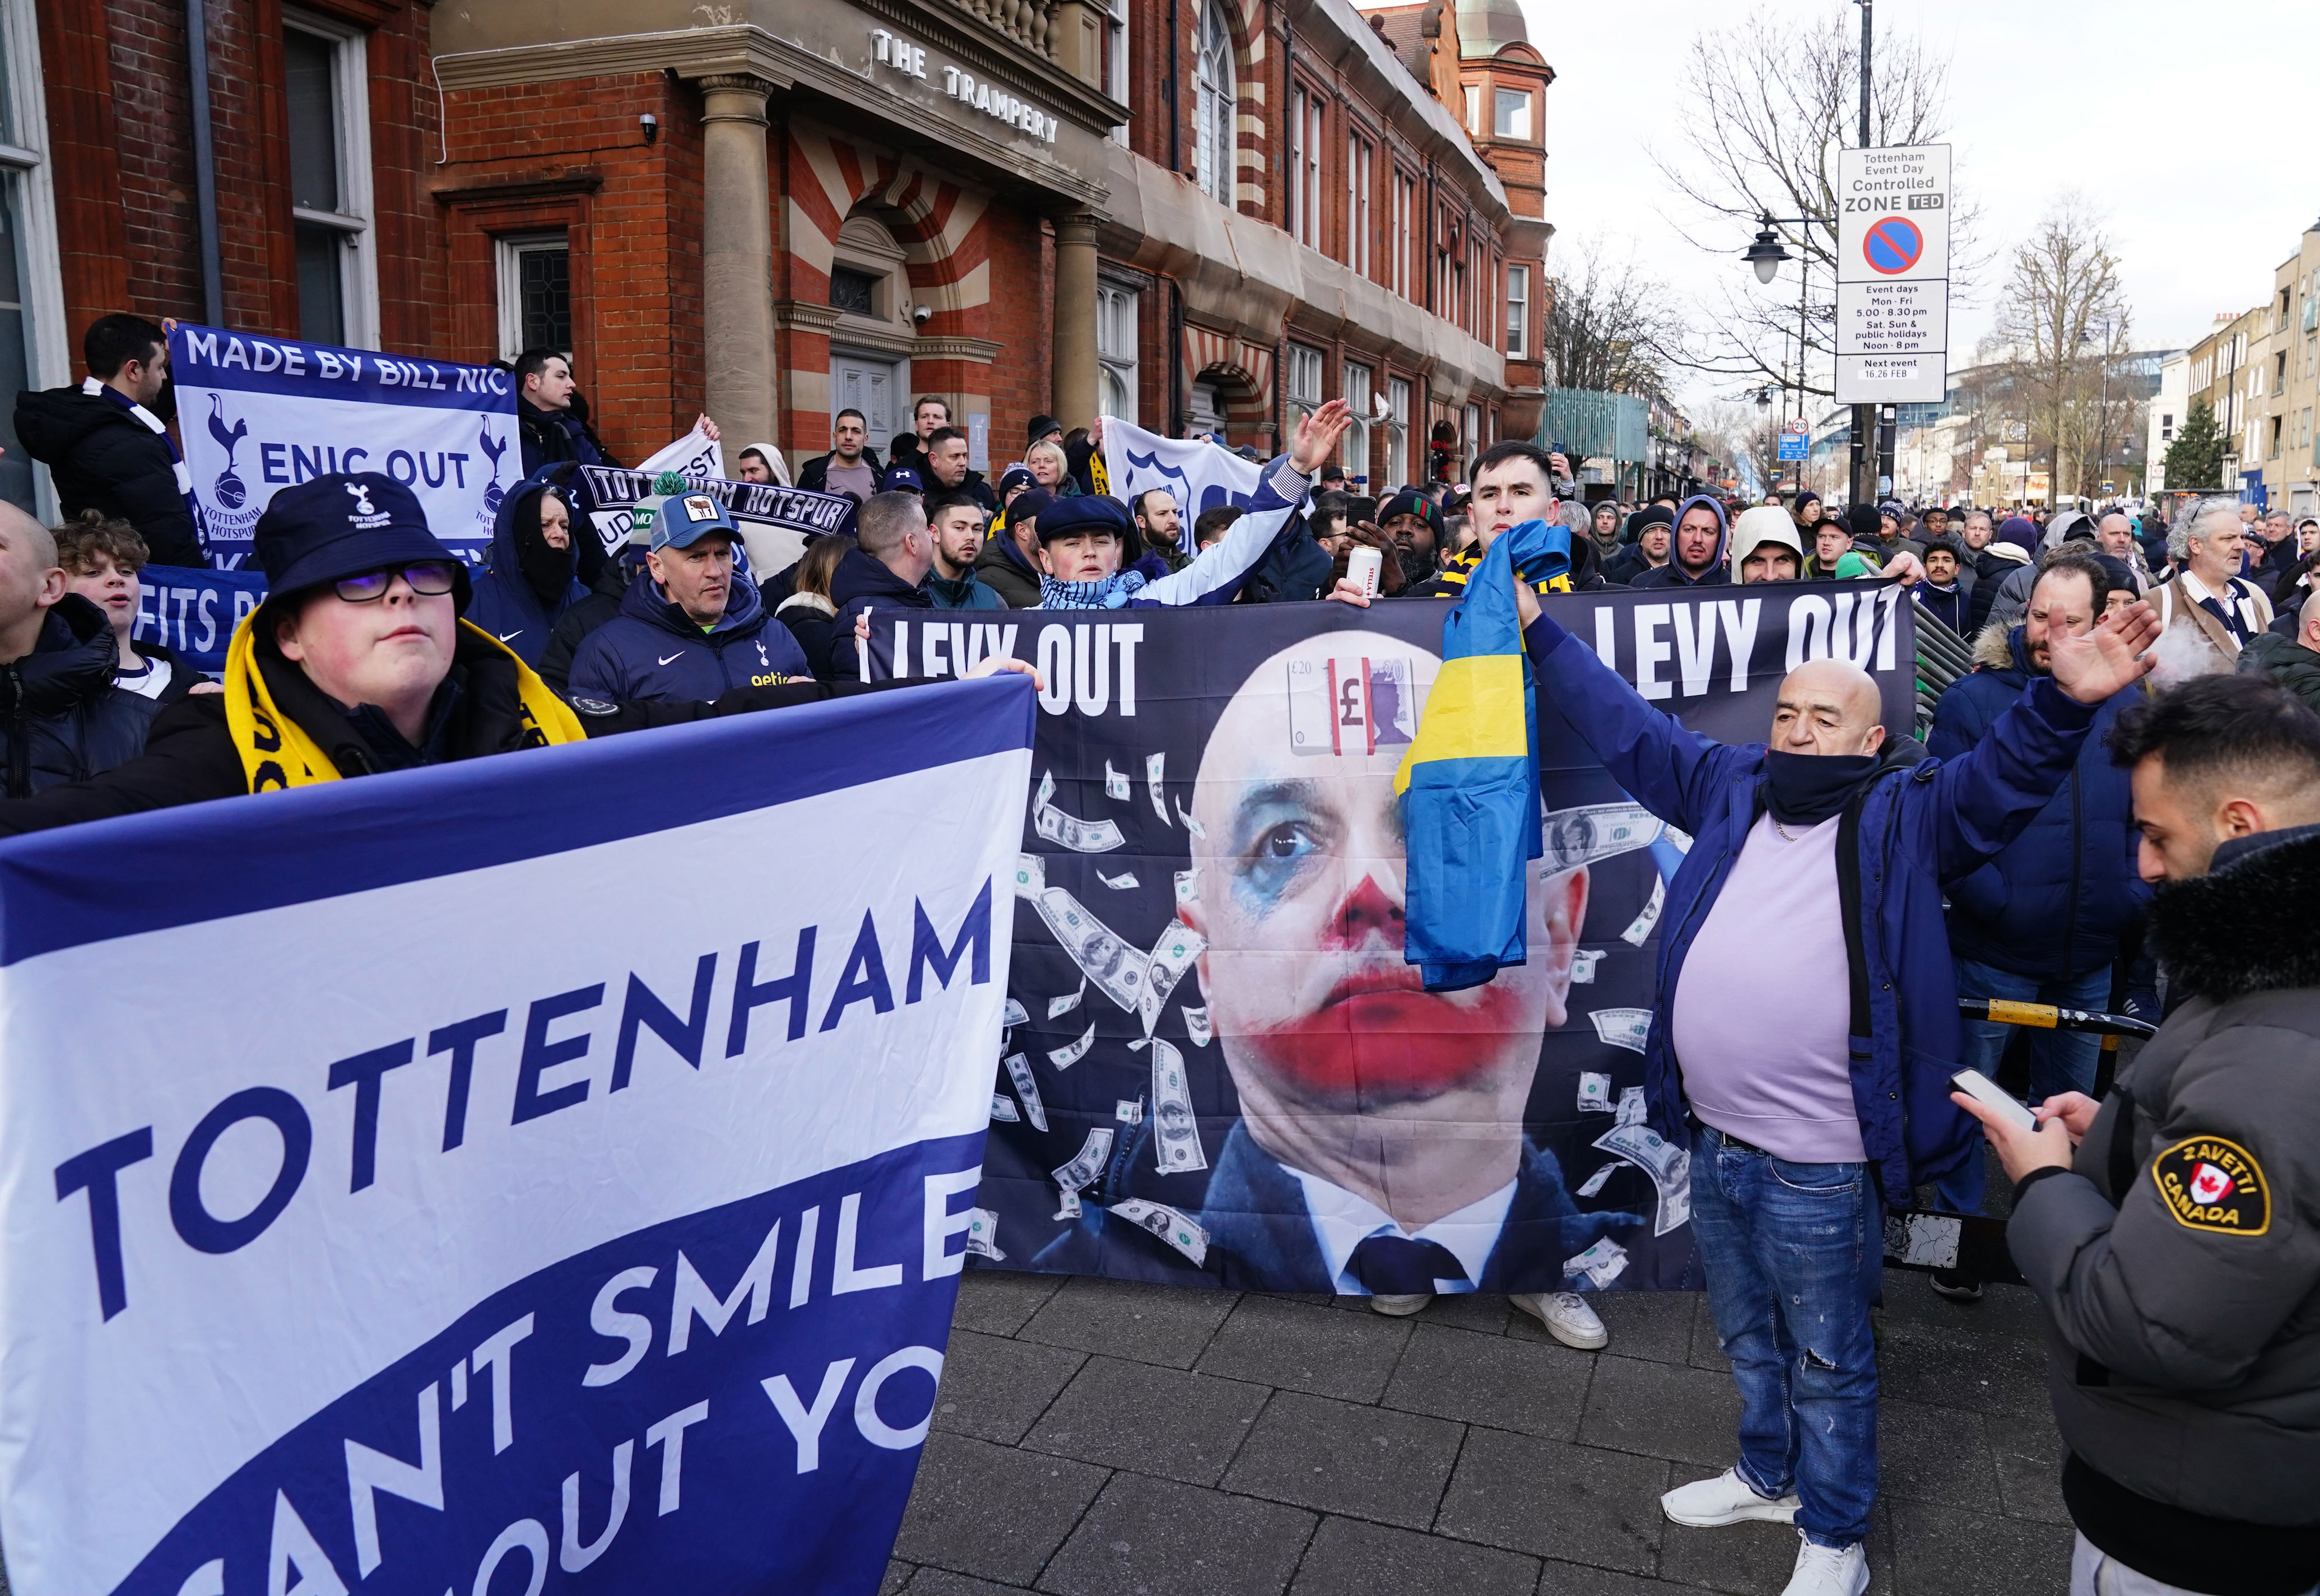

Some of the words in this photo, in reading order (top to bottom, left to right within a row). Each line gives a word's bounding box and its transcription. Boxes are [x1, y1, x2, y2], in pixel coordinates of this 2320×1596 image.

[872, 29, 927, 80] THE
[943, 65, 1058, 143] TRAMPERY
[1863, 152, 1925, 164] Tottenham
[1866, 165, 1898, 175] Event
[1903, 164, 1924, 174] Day
[1845, 196, 1901, 212] ZONE
[1911, 196, 1941, 209] TED
[1852, 176, 1934, 192] Controlled
[1896, 285, 1918, 294] days
[1856, 331, 1884, 339] public
[1888, 330, 1927, 339] holidays
[185, 329, 305, 376] MADE
[320, 351, 362, 381] BY
[373, 359, 447, 390] BILL
[456, 367, 508, 395] NIC
[261, 443, 369, 483] ENIC
[386, 450, 469, 489] OUT
[204, 505, 263, 525] TOTTENHAM
[745, 487, 842, 530] HOTSPUR
[1037, 623, 1144, 716] OUT
[1291, 661, 1312, 674] £20
[1384, 659, 1403, 681] 20
[1594, 598, 1761, 700] LEVY
[54, 873, 992, 1323] TOTTENHAM
[2183, 1143, 2257, 1194] ZAVETTI
[2164, 1172, 2239, 1226] CANADA
[582, 1166, 983, 1388] SMILE
